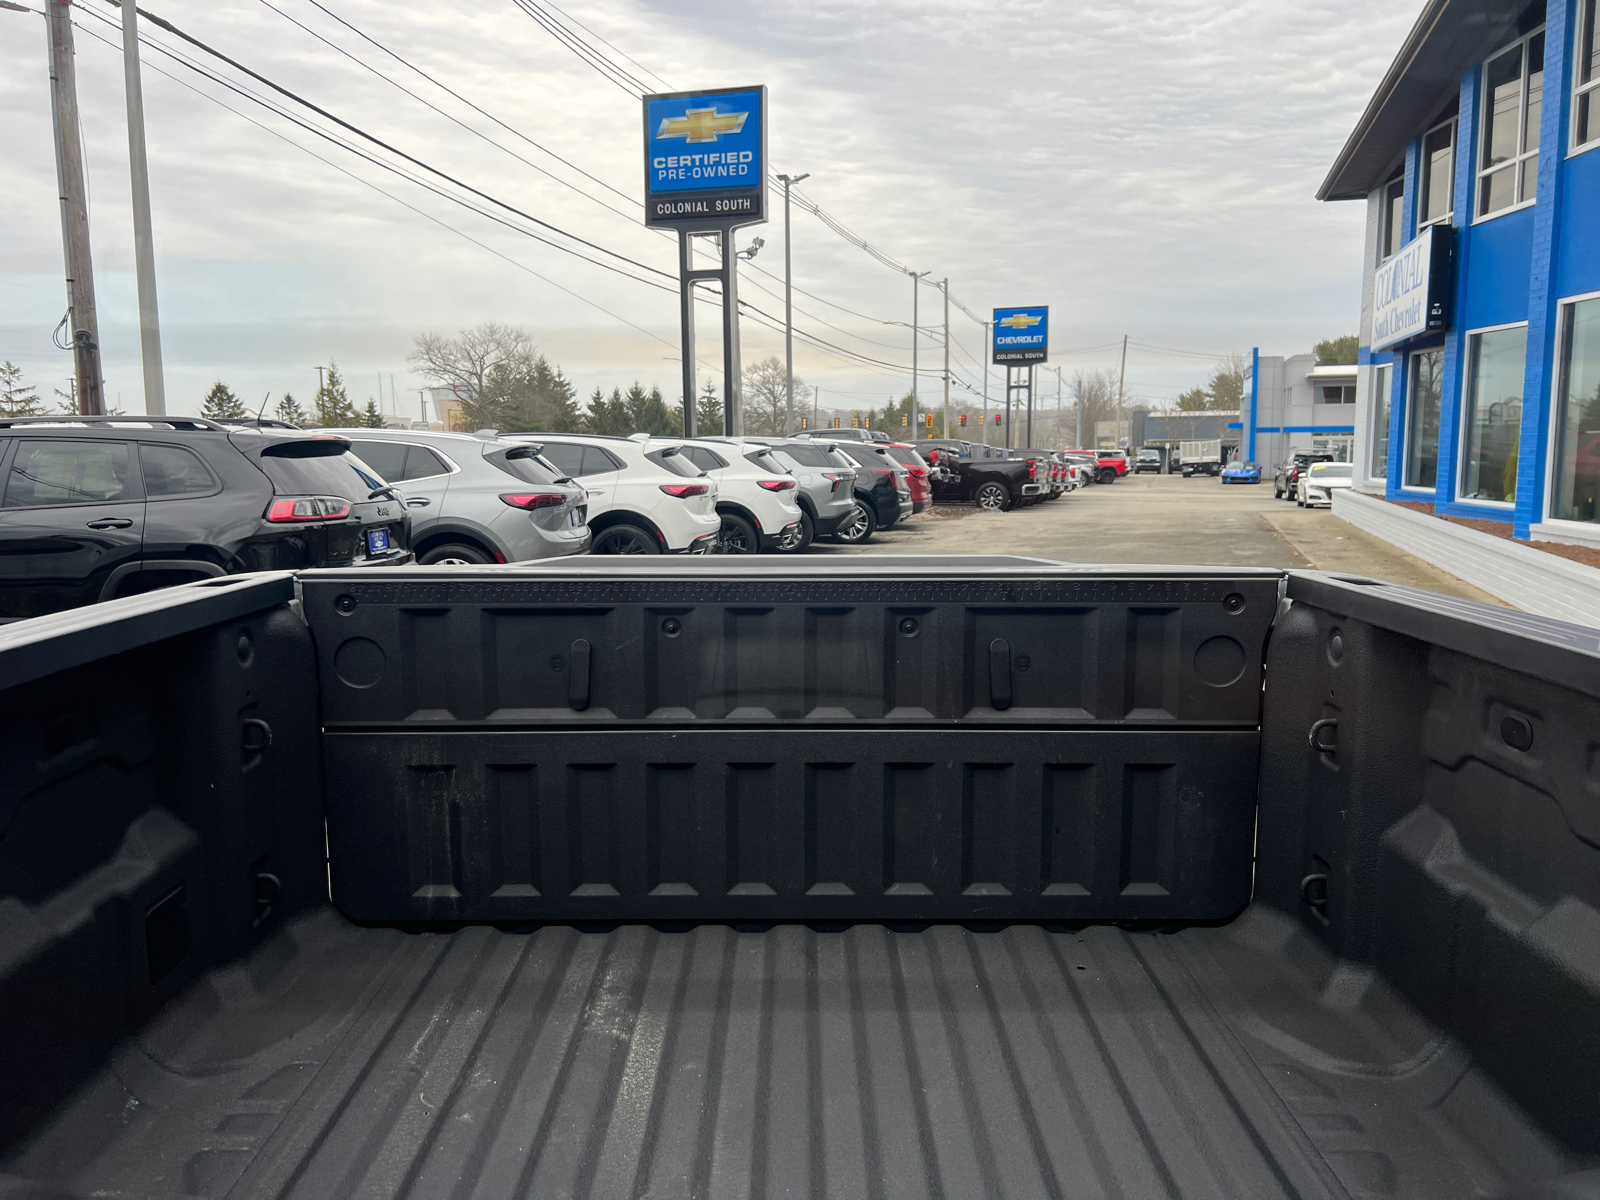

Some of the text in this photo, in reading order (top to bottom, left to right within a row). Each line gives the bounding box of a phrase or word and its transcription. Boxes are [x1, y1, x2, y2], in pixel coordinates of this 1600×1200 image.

[653, 151, 753, 169] CERTIFIED
[658, 164, 748, 181] PRE-OWNED
[657, 199, 750, 215] COLONIAL SOUTH
[1376, 244, 1424, 312] COLONIAL
[1374, 297, 1422, 342] South Chevrolet
[997, 335, 1044, 345] CHEVROLET
